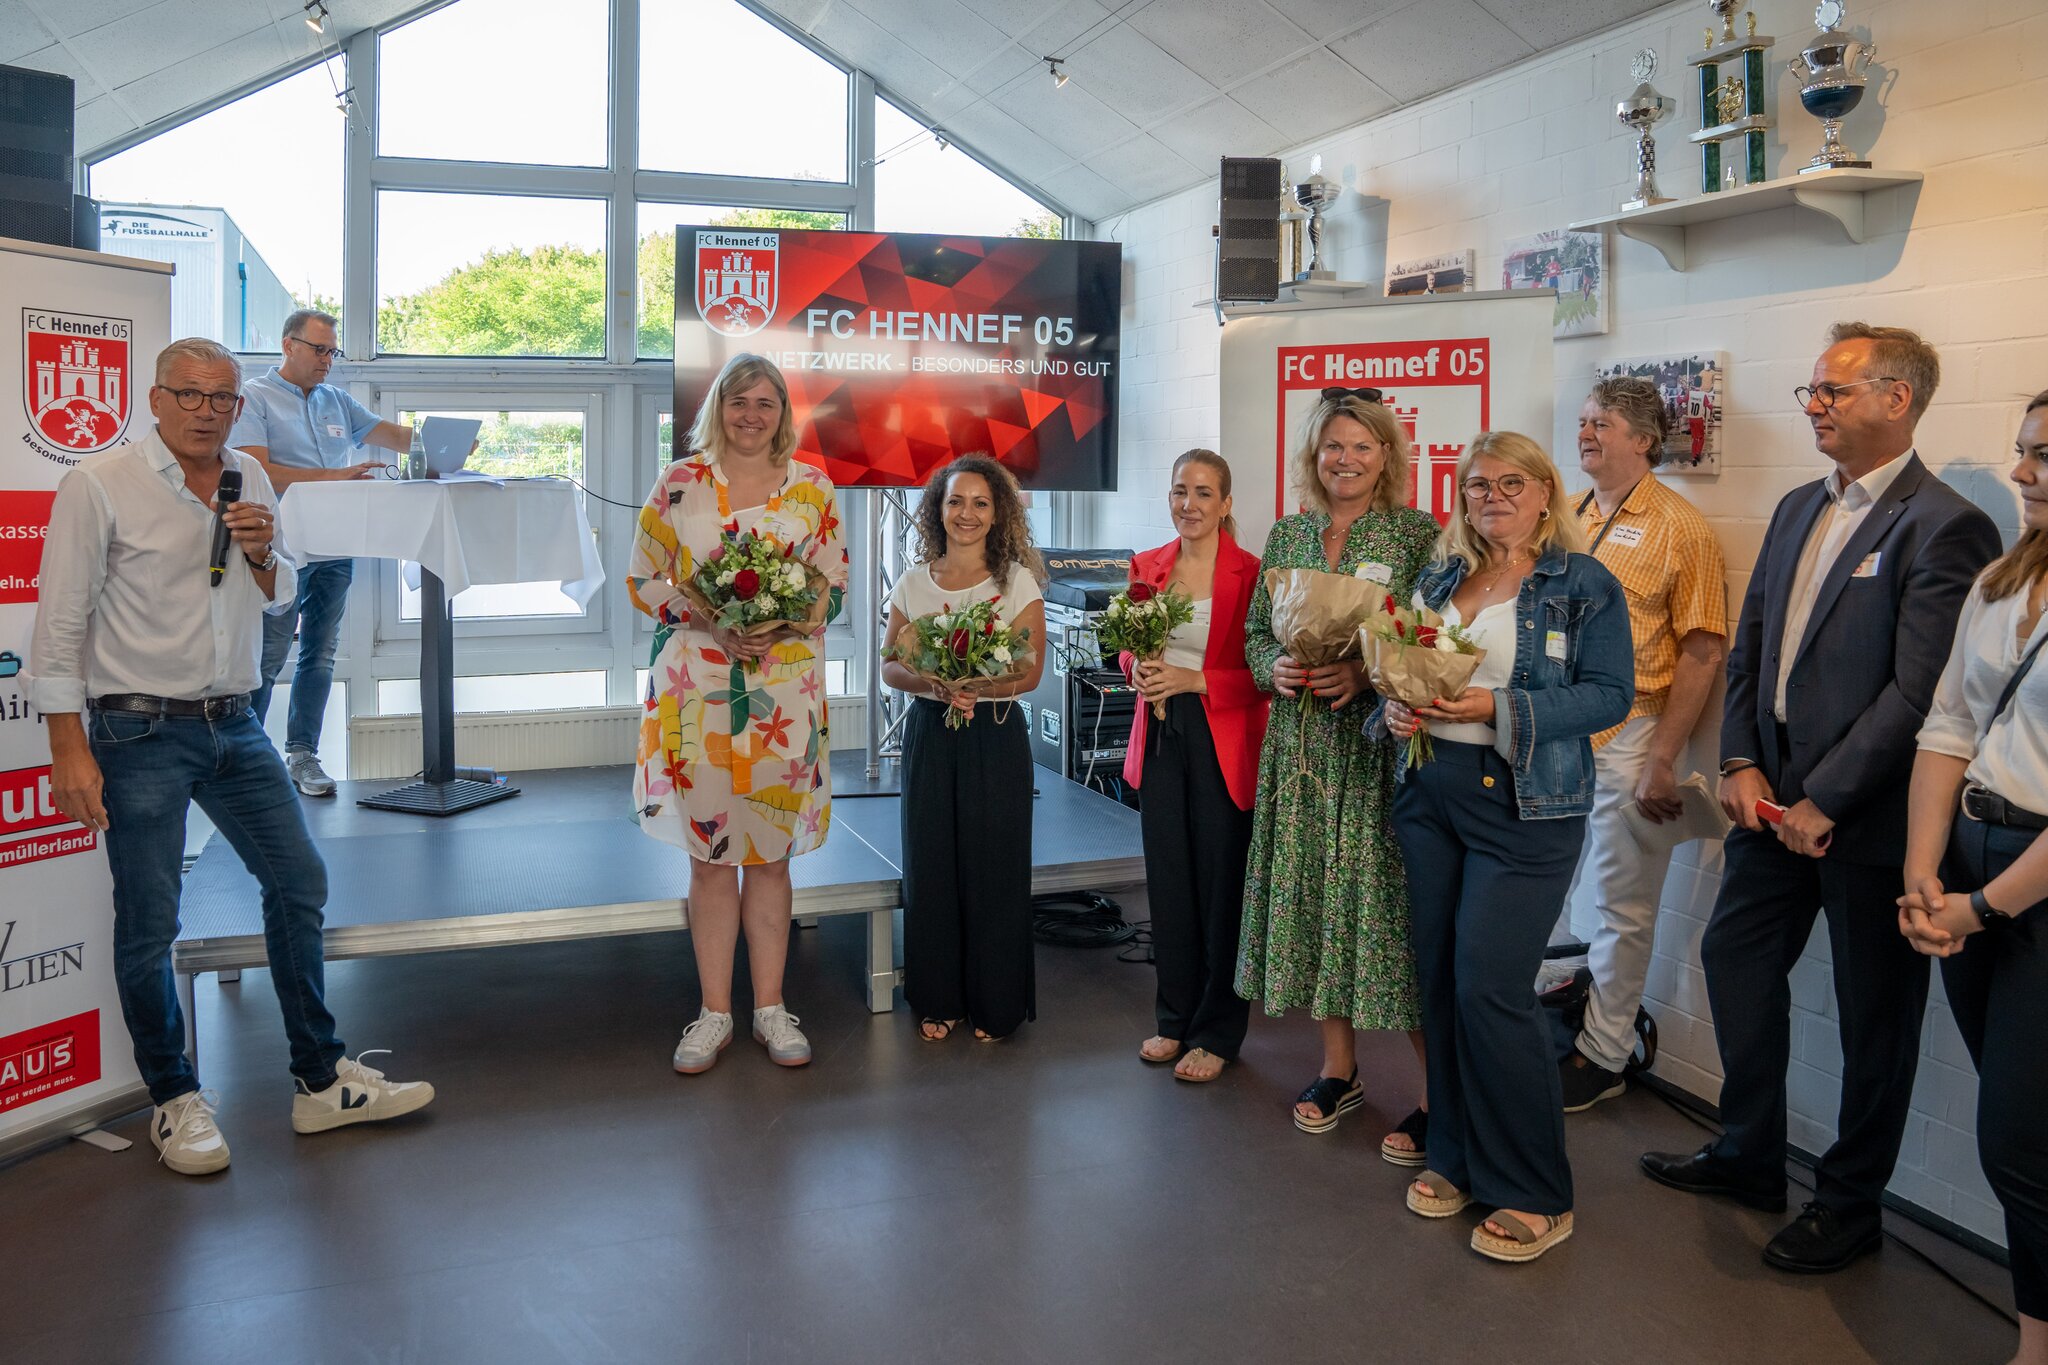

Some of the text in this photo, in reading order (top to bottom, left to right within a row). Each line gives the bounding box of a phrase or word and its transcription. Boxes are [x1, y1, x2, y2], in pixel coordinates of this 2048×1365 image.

[122, 228, 208, 237] FUSSBALLHALLE
[699, 235, 776, 247] FC Hennef 05
[28, 314, 128, 338] FC Hennef 05
[807, 308, 1074, 346] FC HENNEF 05
[765, 351, 892, 371] NETZWERK
[912, 357, 1025, 375] BESONDERS
[1030, 360, 1069, 375] UND
[1073, 361, 1111, 377] GUT
[1284, 347, 1484, 381] FC Hennef 05
[1691, 402, 1700, 416] 10
[22, 433, 81, 466] besonder
[0, 832, 94, 863] müllerland
[2, 946, 85, 992] LIEN
[0, 1043, 71, 1086] AUS
[5, 1075, 76, 1105] gut werden muss.
